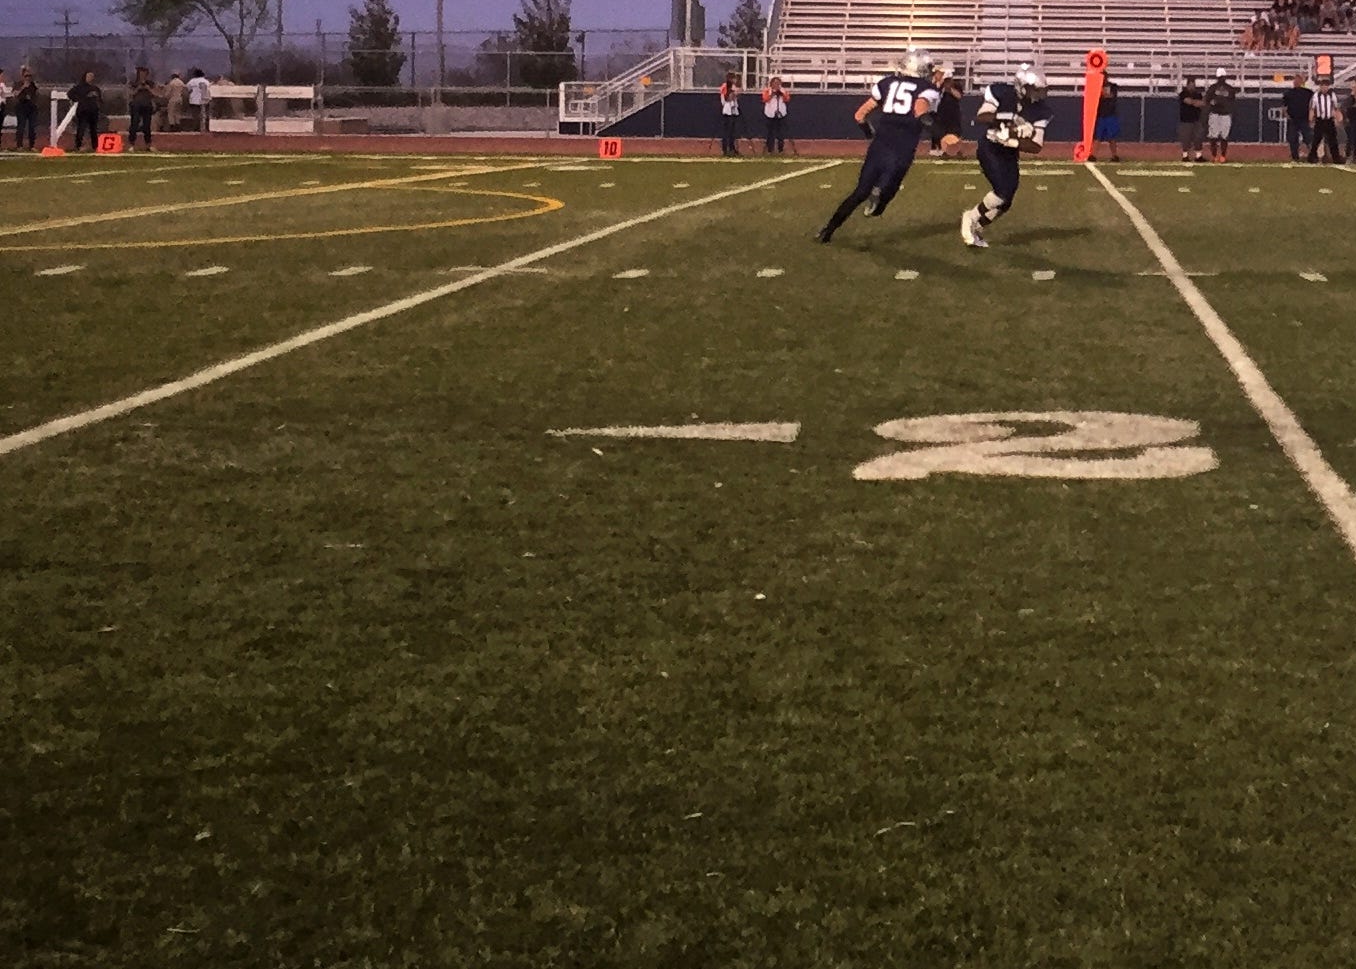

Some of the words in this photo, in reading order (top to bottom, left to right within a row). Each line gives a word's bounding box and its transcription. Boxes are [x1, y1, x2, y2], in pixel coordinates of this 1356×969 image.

[883, 80, 917, 114] 15
[102, 136, 115, 151] G
[604, 141, 617, 155] 10
